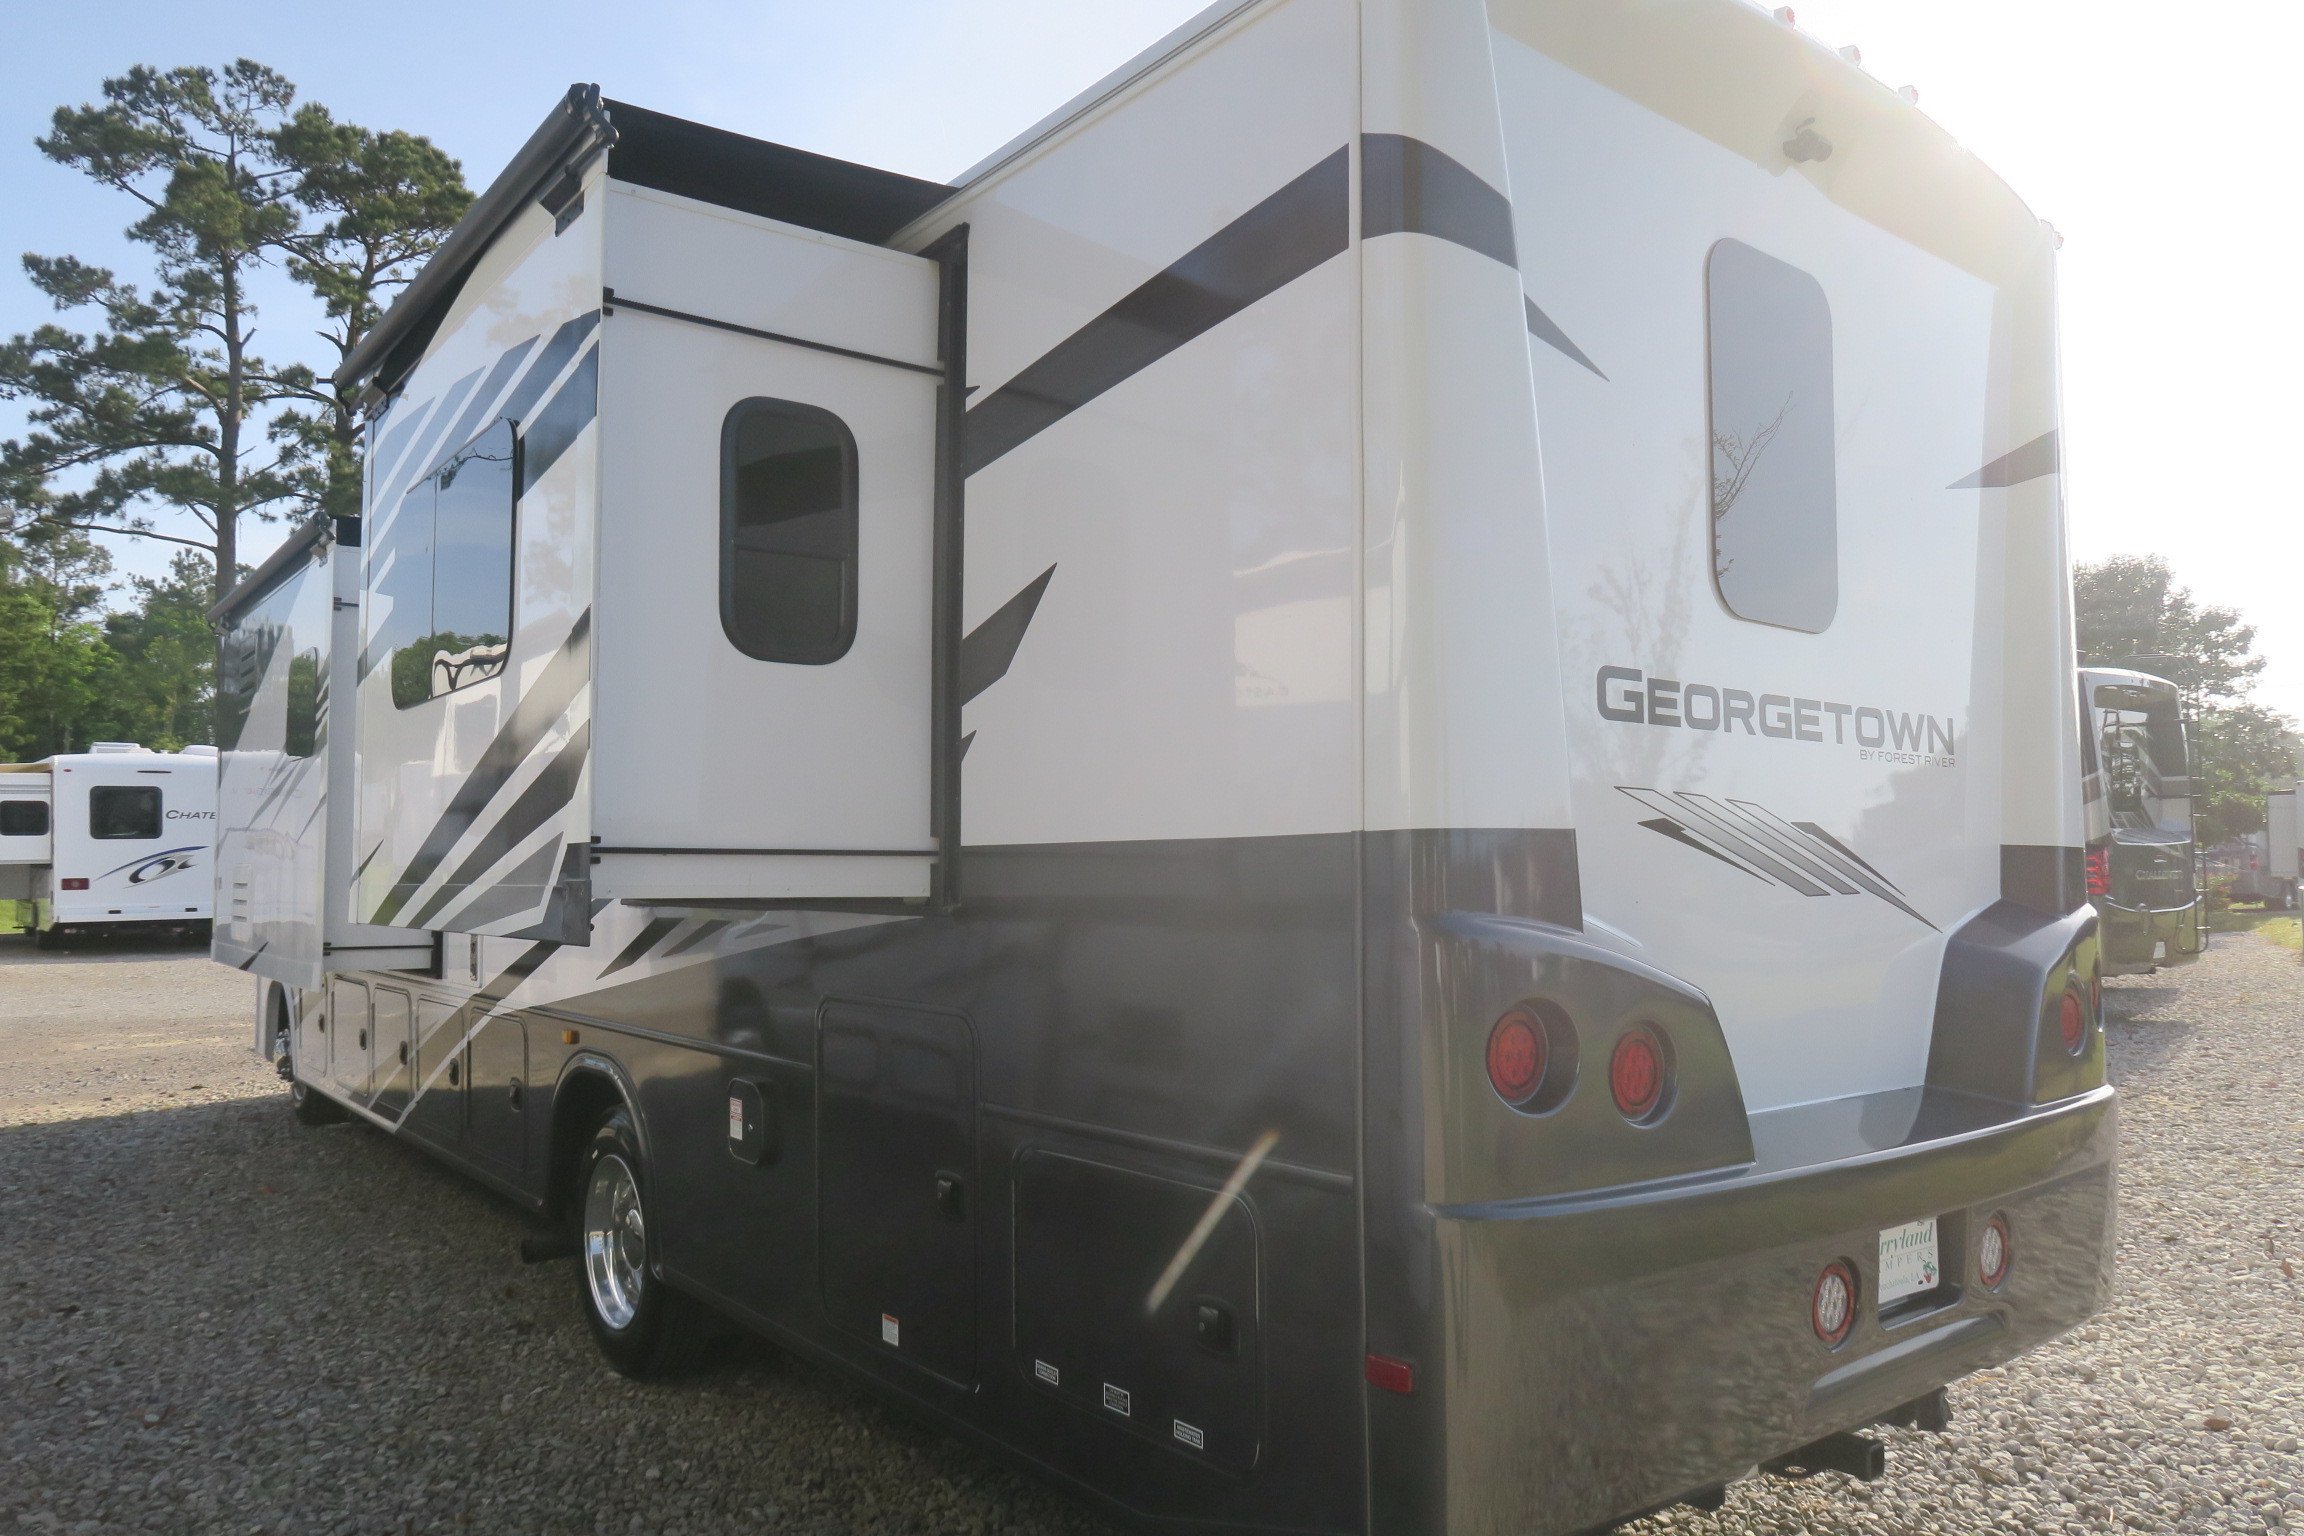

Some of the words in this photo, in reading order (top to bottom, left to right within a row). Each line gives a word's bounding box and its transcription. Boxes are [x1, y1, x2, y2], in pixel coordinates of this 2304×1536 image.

[1596, 664, 1955, 756] GEORGETOWN
[1859, 749, 1875, 761] BY
[1878, 751, 1922, 765] FOREST
[1925, 755, 1957, 768] RIVER
[165, 809, 217, 820] CHATE
[1879, 1221, 1933, 1257] rryland
[1884, 1248, 1934, 1271] MPERS
